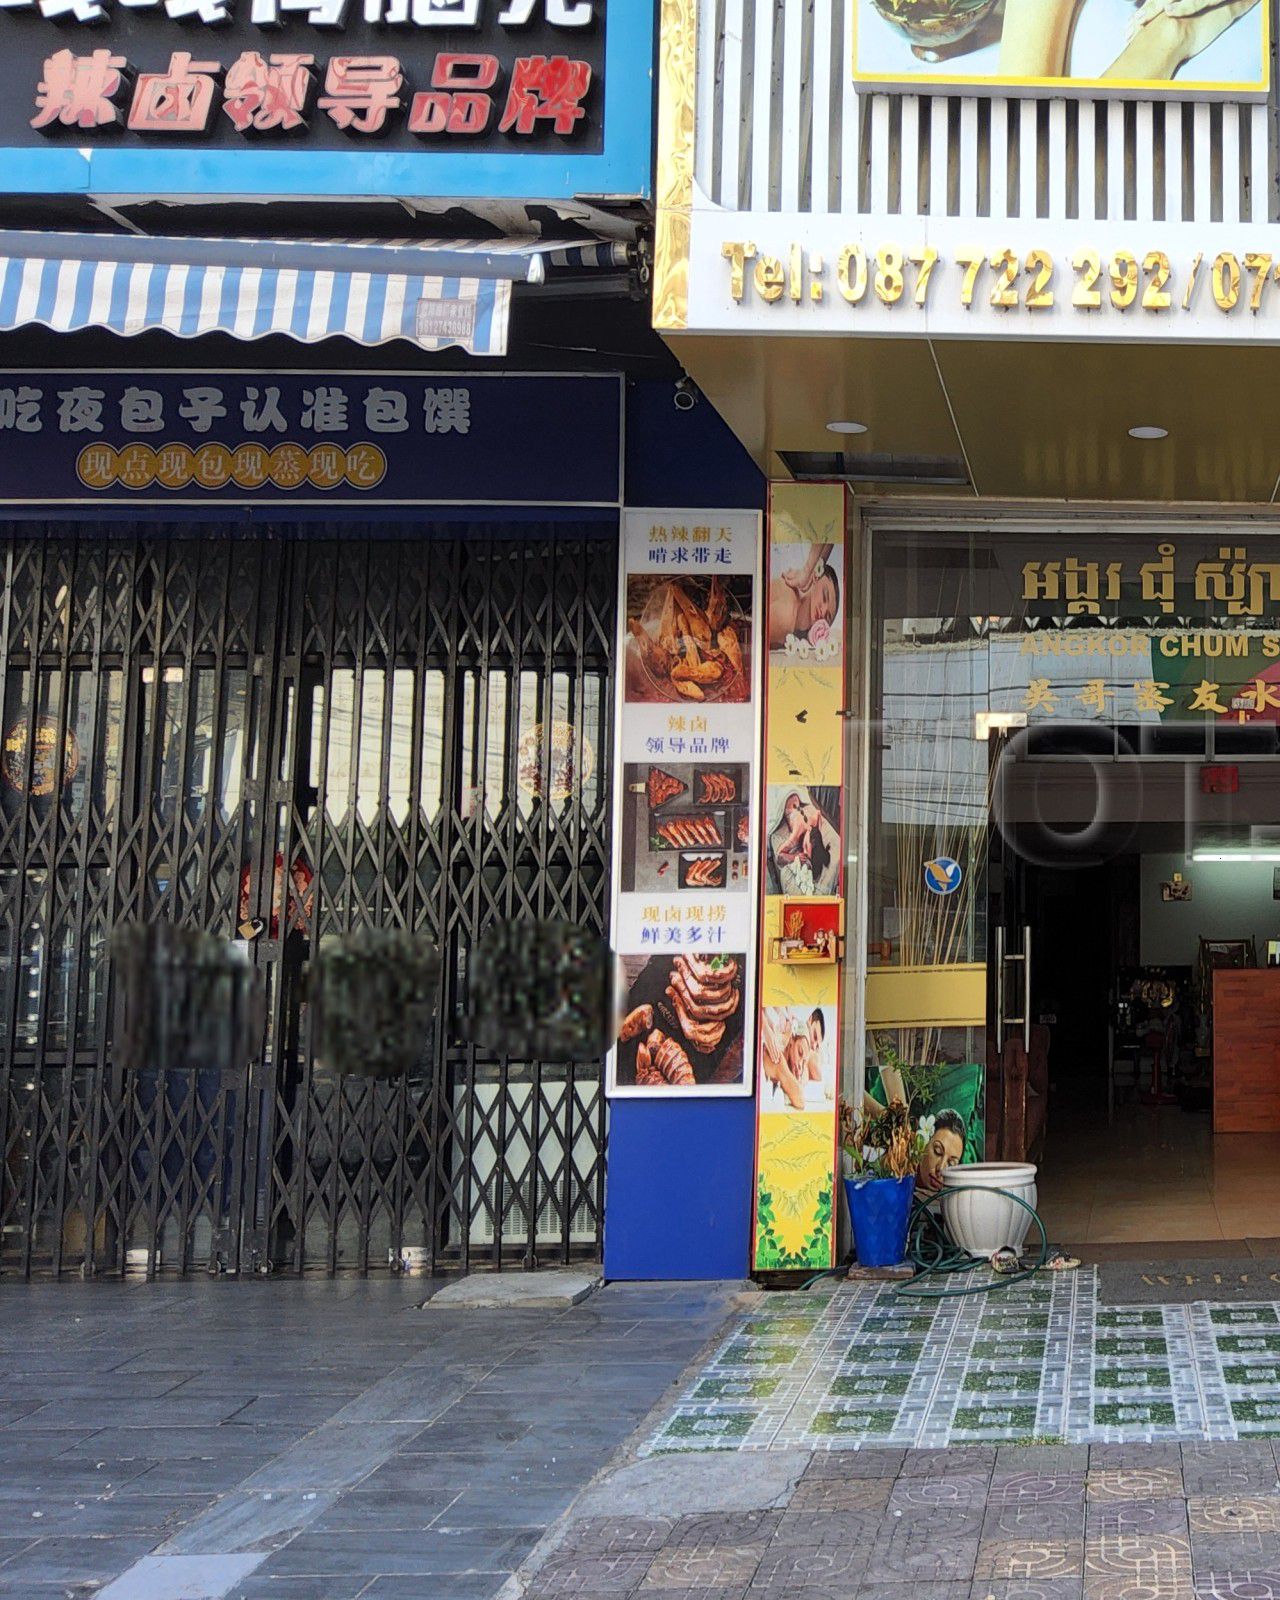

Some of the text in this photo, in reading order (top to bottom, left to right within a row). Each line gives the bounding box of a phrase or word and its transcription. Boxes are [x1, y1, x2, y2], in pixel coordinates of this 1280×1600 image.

[30, 49, 593, 133] 辣卤领导品牌
[956, 249, 1054, 309] 722
[83, 448, 378, 482] 现点现包现蒸现吃
[649, 525, 732, 543] 热辣翻天
[648, 546, 733, 565] 啃求带走
[1021, 635, 1149, 657] ANGKOR
[1159, 634, 1249, 658] CHUM
[666, 715, 708, 732] 辣卤
[645, 738, 730, 754] 领导品牌
[641, 905, 728, 923] 现卤现捞
[640, 926, 728, 945] 鲜美多汁
